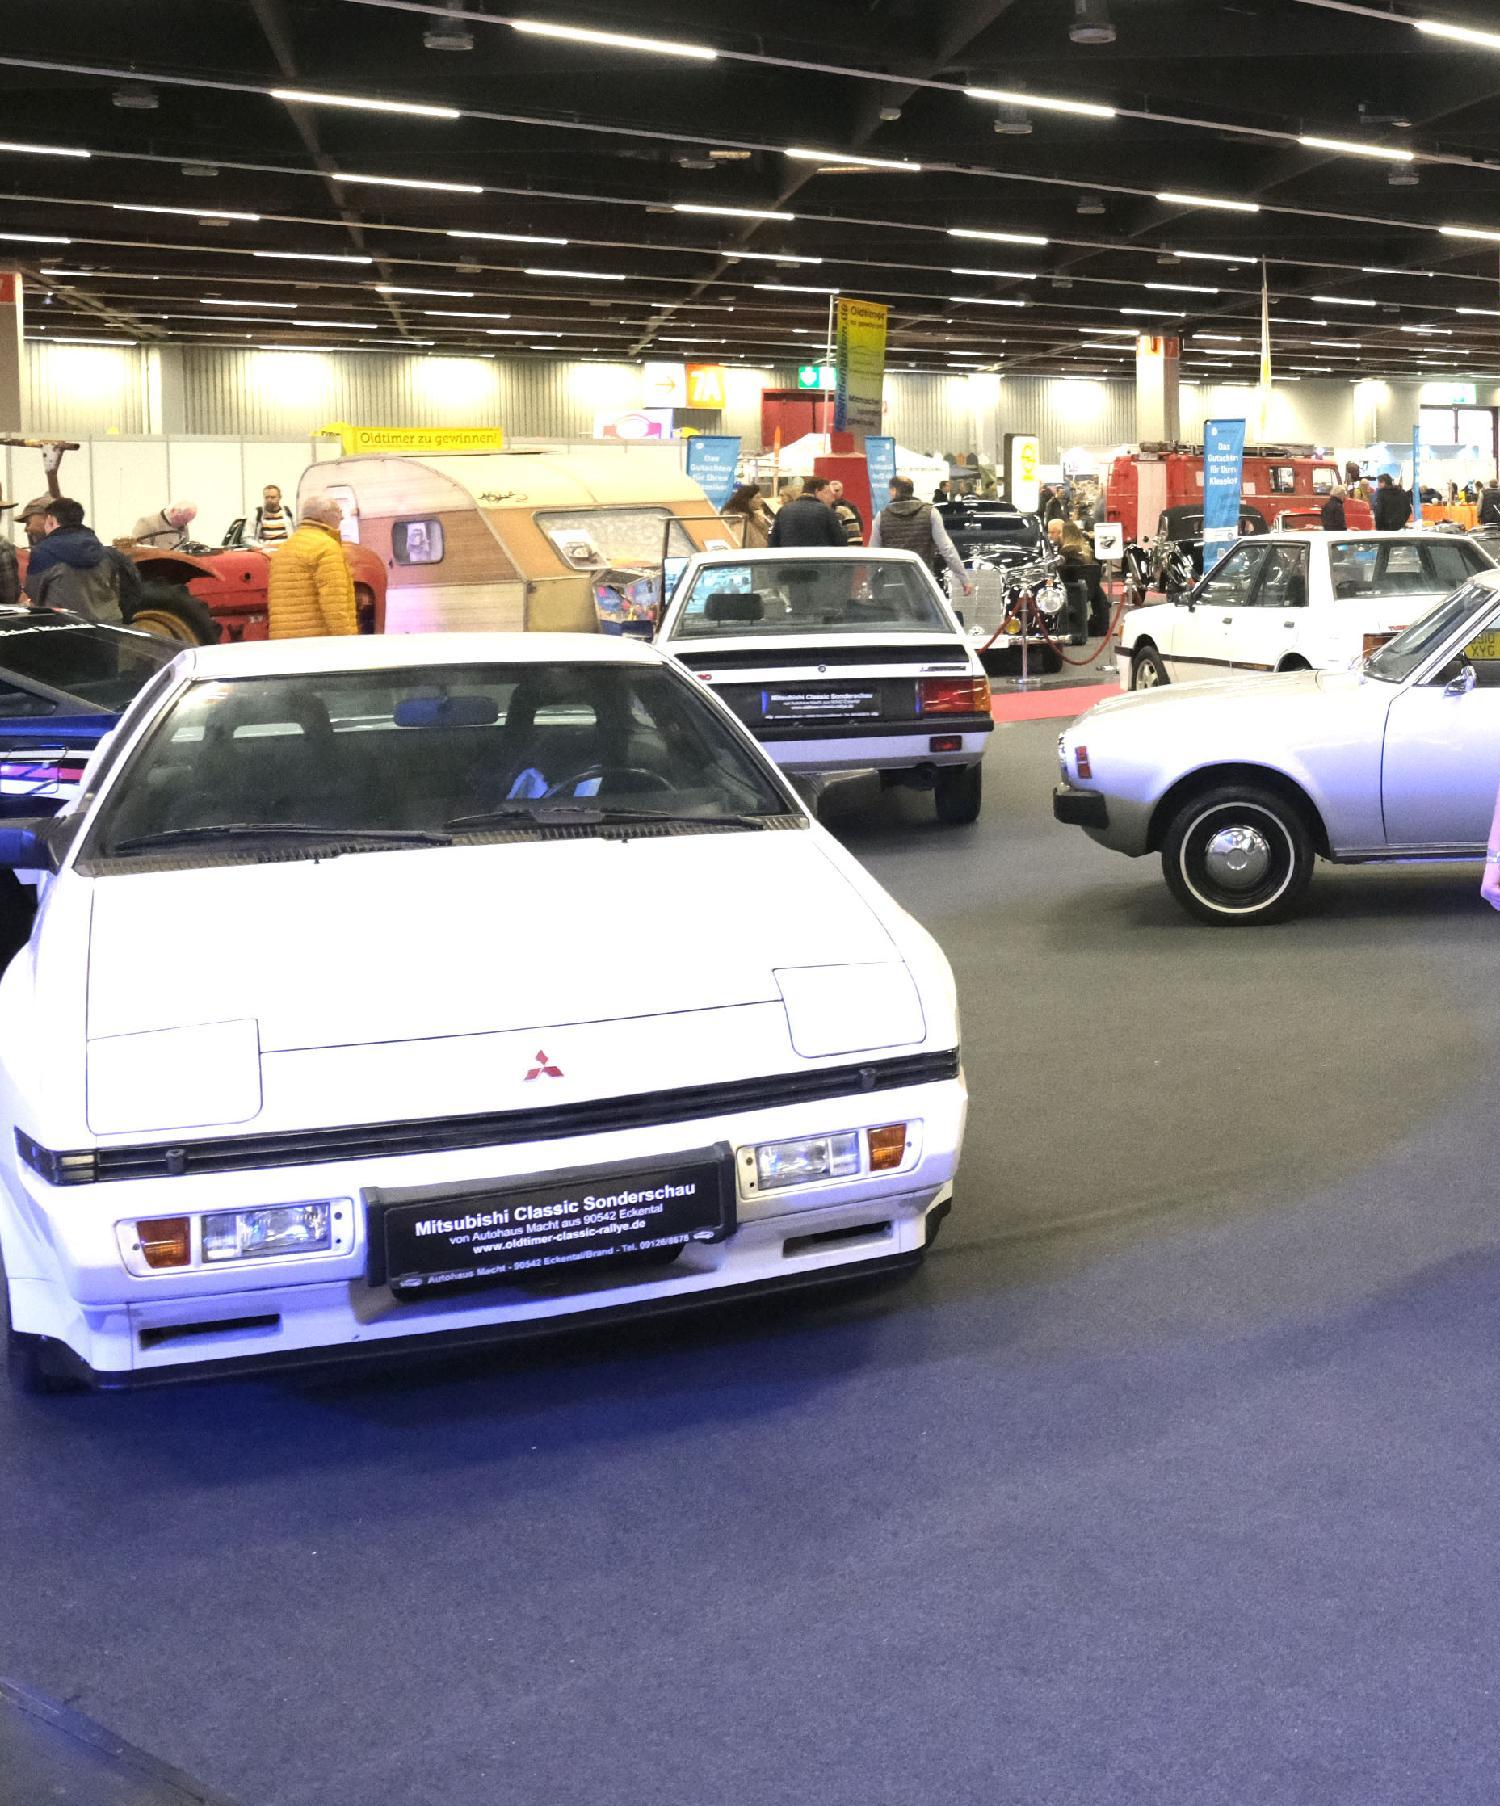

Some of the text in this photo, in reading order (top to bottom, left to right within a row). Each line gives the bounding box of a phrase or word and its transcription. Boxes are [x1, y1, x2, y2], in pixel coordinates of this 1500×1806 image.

[690, 371, 722, 402] 7A
[360, 432, 498, 446] Oldtimer zu gewinnen!
[415, 1183, 696, 1237] Mitsubishi Classic Sonderschau
[449, 1202, 664, 1245] von Autohaus Macht aus 90542 Eckental
[472, 1219, 646, 1255] www.oldtimer-classic-rallye.de
[427, 1269, 475, 1284] Autohaus
[476, 1264, 506, 1276] Macht
[621, 1243, 638, 1254] Tel.
